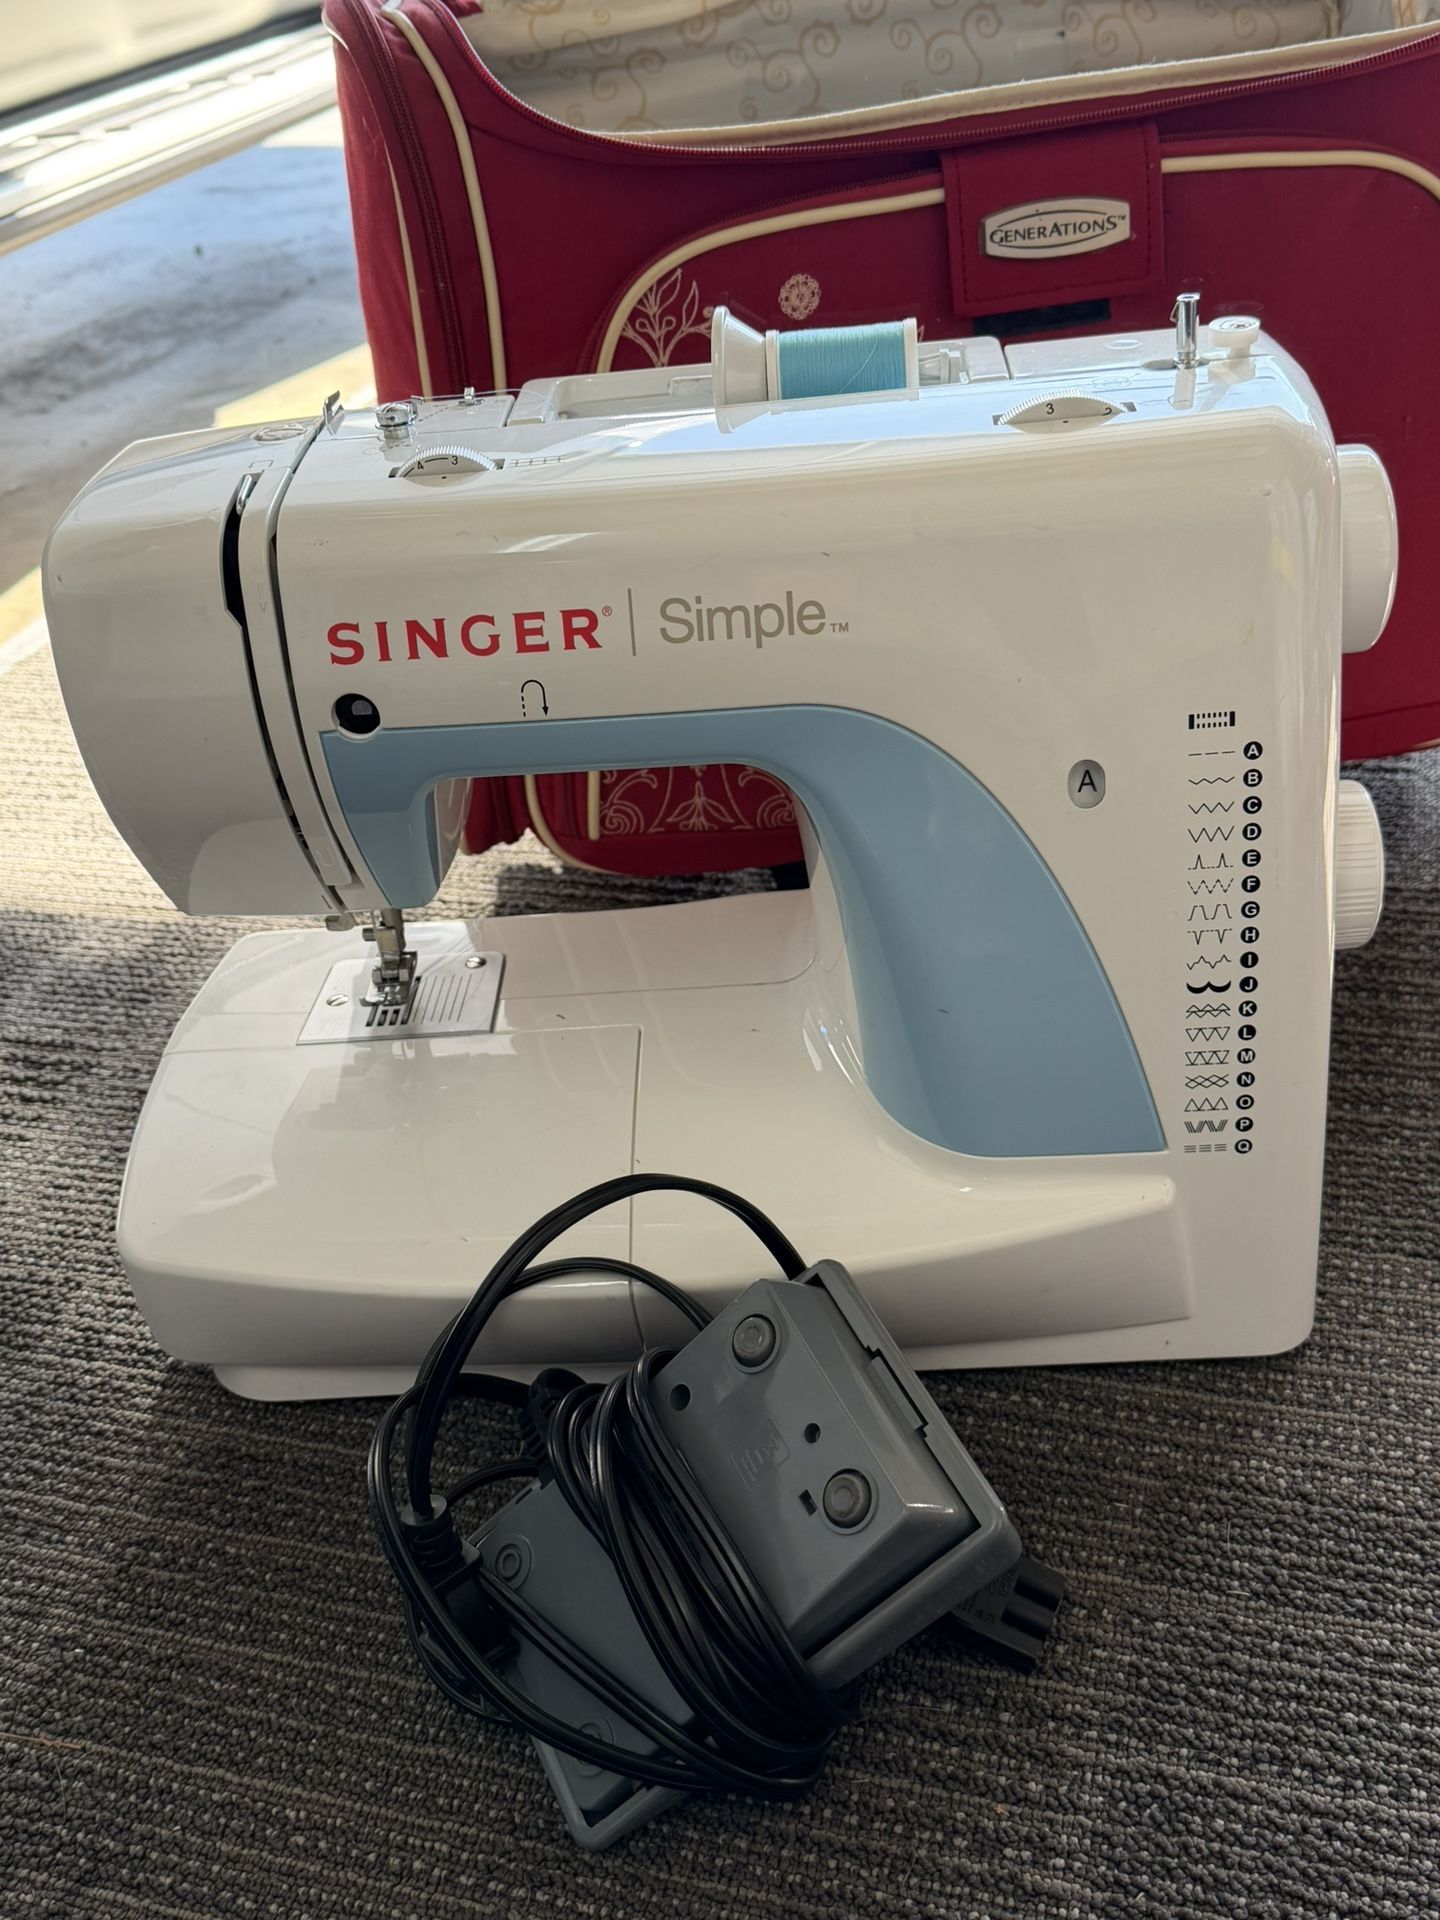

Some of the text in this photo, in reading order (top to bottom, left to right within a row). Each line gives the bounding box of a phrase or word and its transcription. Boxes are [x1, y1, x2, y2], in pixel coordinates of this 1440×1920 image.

[1045, 402, 1055, 415] 3
[417, 455, 459, 470] 4 3
[1077, 769, 1098, 793] A
